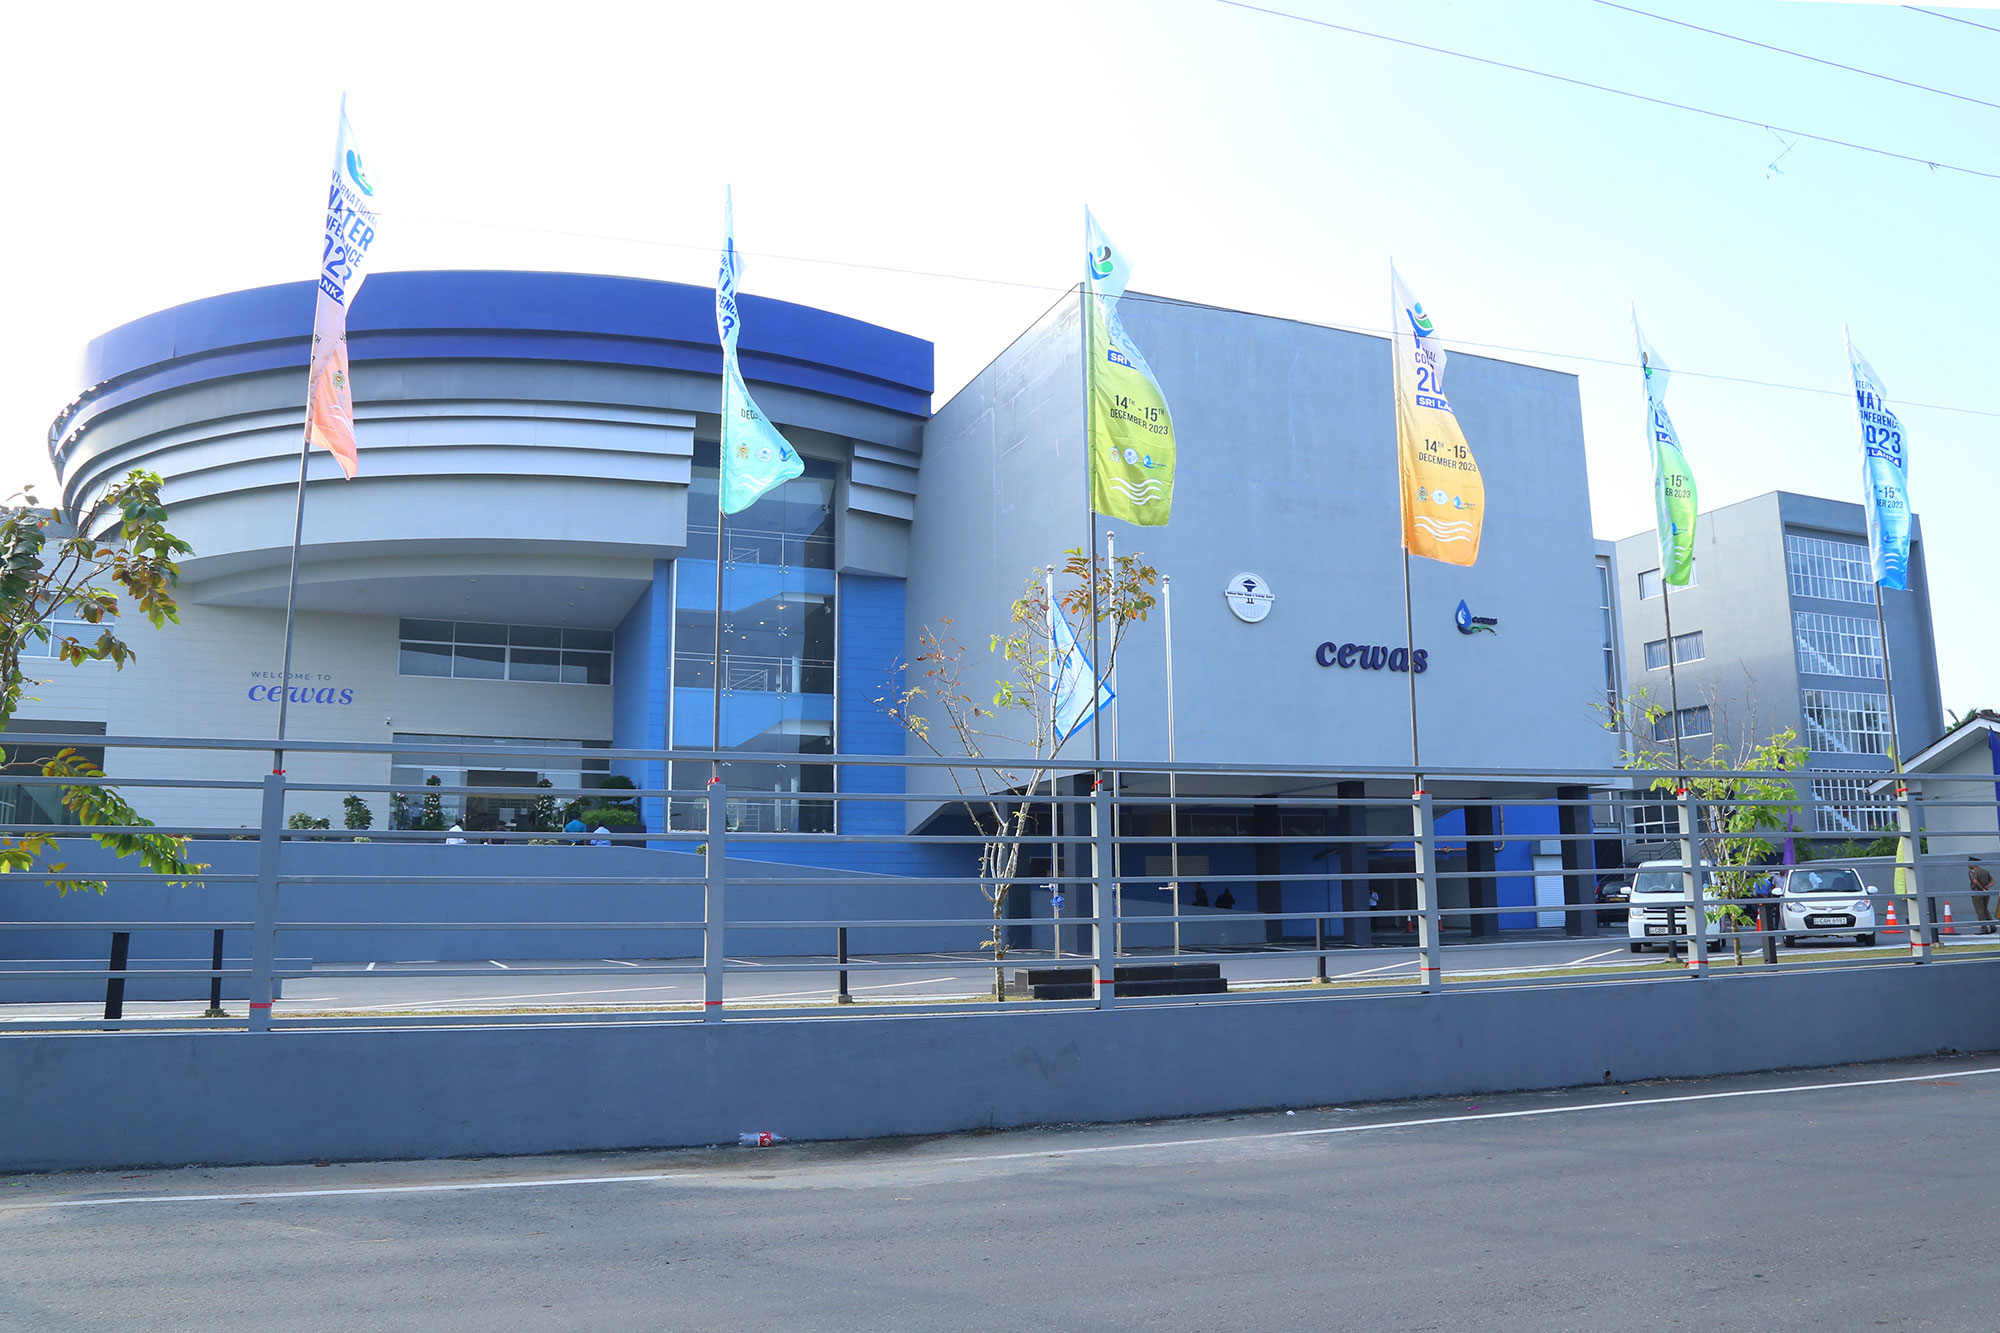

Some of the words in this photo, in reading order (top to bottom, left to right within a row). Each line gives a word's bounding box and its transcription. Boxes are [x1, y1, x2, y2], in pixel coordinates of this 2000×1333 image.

[1110, 352, 1128, 364] SRI
[1419, 397, 1436, 407] SRI
[1110, 408, 1147, 429] DECEMBER
[1148, 423, 1169, 435] 2023
[1418, 452, 1457, 469] DECEMBER
[1458, 461, 1477, 472] 2023
[1674, 489, 1691, 499] 2023
[1888, 500, 1904, 509] 2023
[1316, 642, 1428, 674] cewas
[251, 671, 310, 681] WELCOME
[317, 673, 331, 681] TO
[248, 685, 354, 705] cewas
